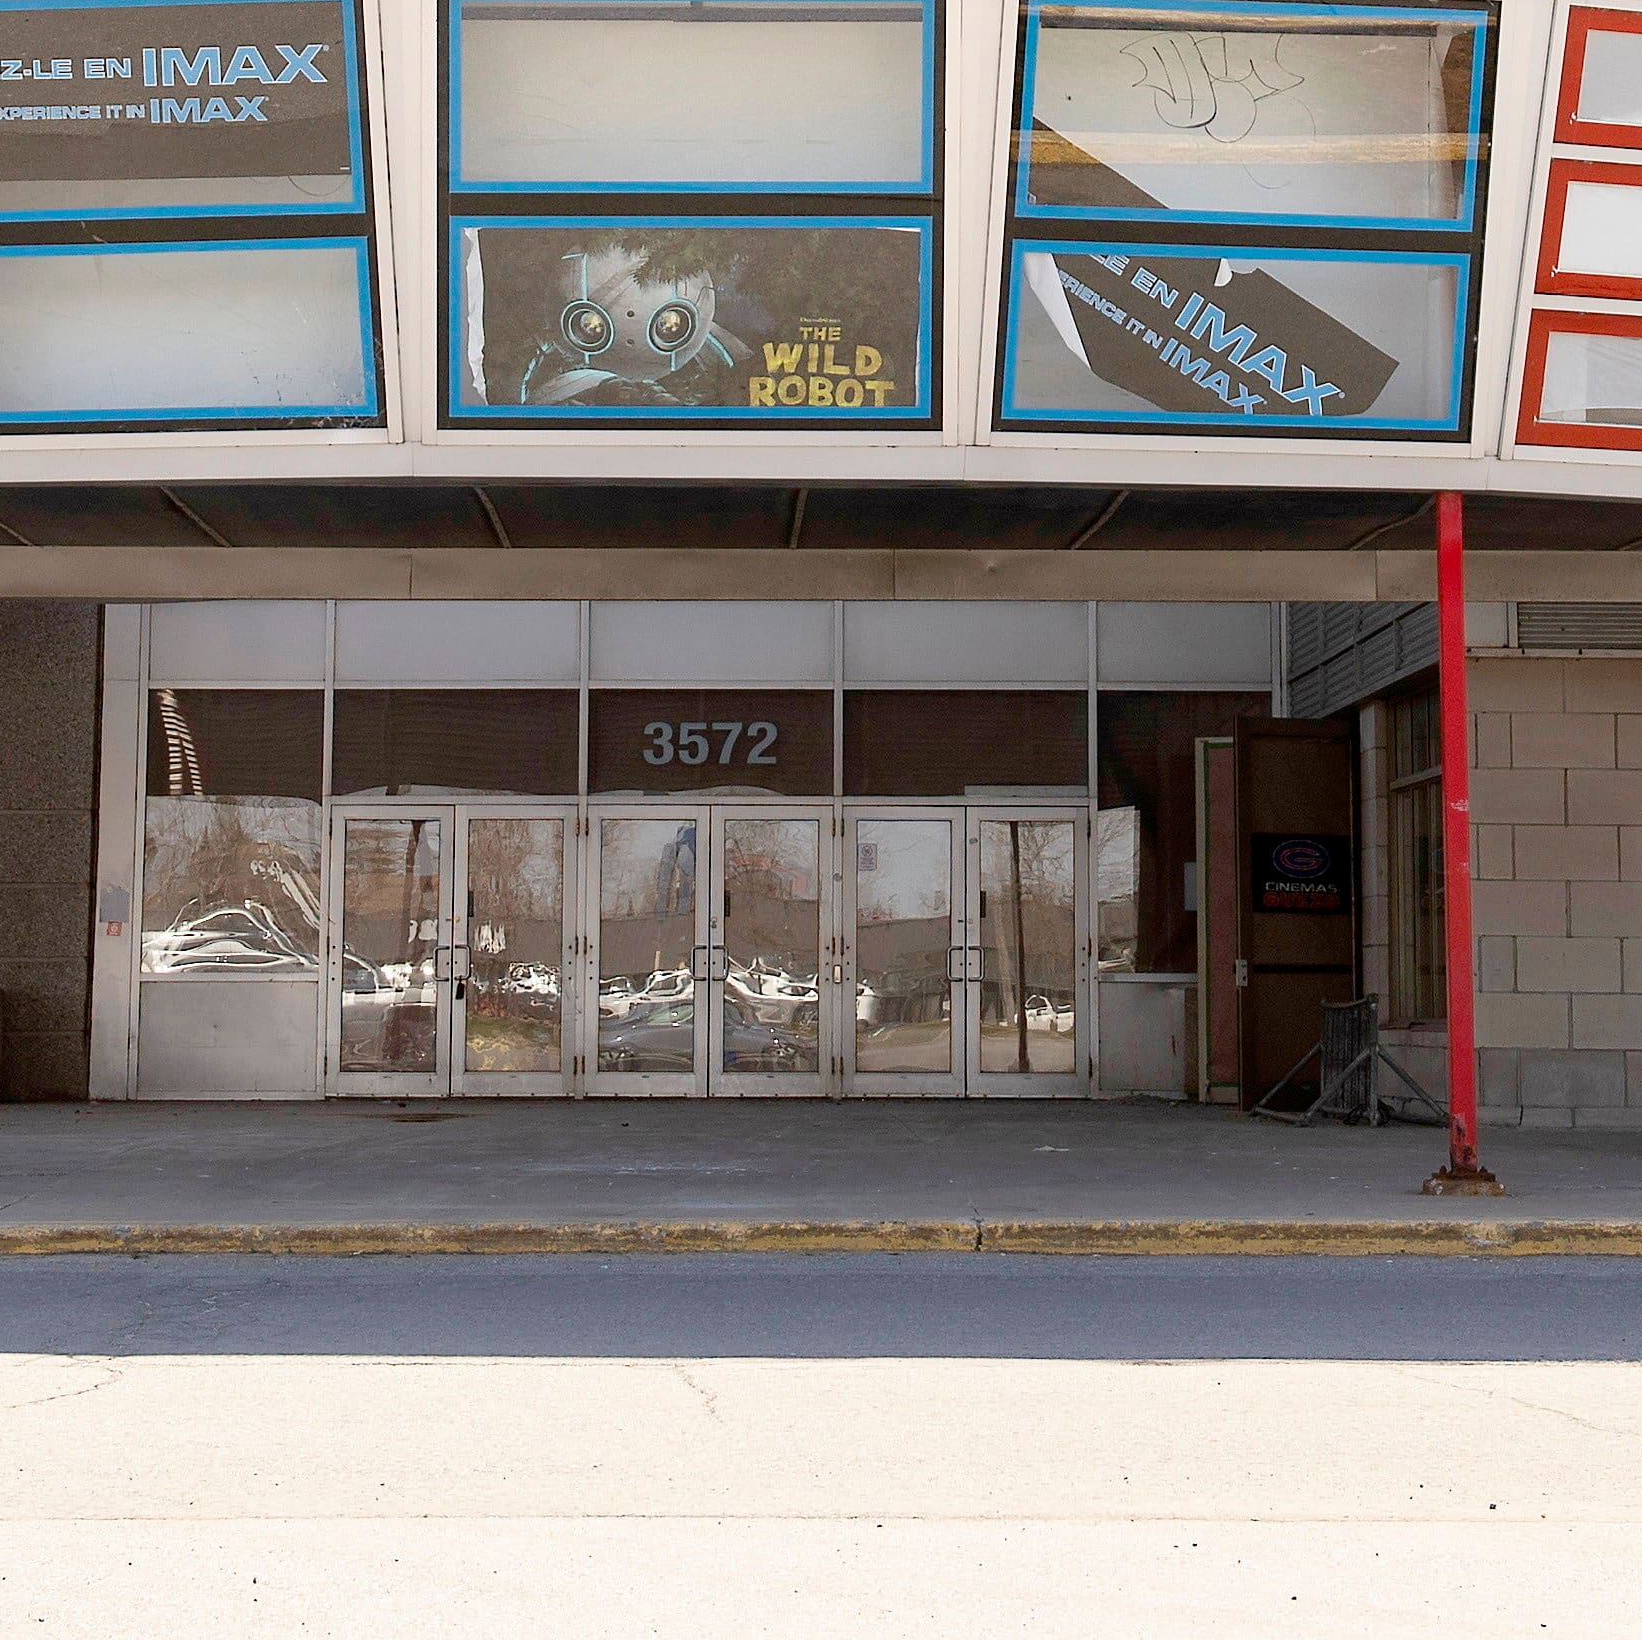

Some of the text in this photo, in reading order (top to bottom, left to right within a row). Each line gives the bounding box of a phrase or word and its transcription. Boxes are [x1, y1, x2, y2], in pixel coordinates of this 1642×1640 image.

[83, 57, 132, 79] EN
[105, 104, 123, 119] IT
[125, 103, 146, 119] IN
[1131, 266, 1180, 309] EN
[799, 326, 842, 341] THE
[1125, 317, 1146, 335] IT
[1142, 329, 1164, 349] IN
[762, 342, 883, 376] WILD
[749, 374, 896, 407] ROBOT
[642, 721, 778, 765] 3572
[1265, 881, 1338, 894] CINEMAS
